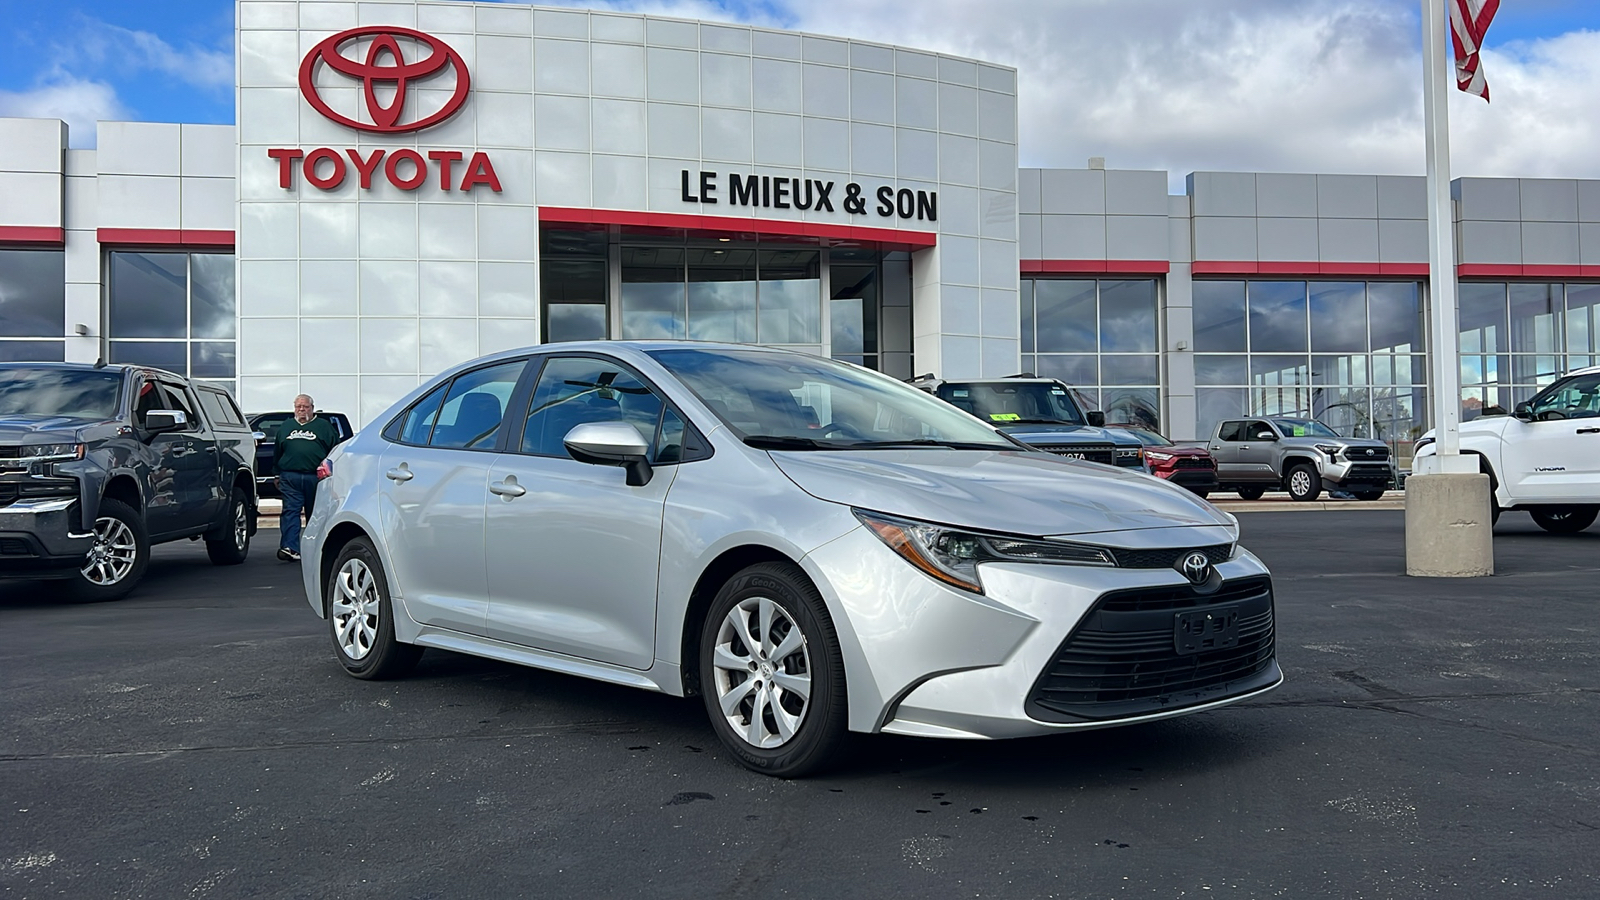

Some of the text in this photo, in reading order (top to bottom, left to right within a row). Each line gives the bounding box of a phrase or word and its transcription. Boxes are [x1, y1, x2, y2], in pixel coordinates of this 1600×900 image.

[267, 147, 503, 193] TOYOTA
[681, 169, 938, 222] LE MIEUX & SON
